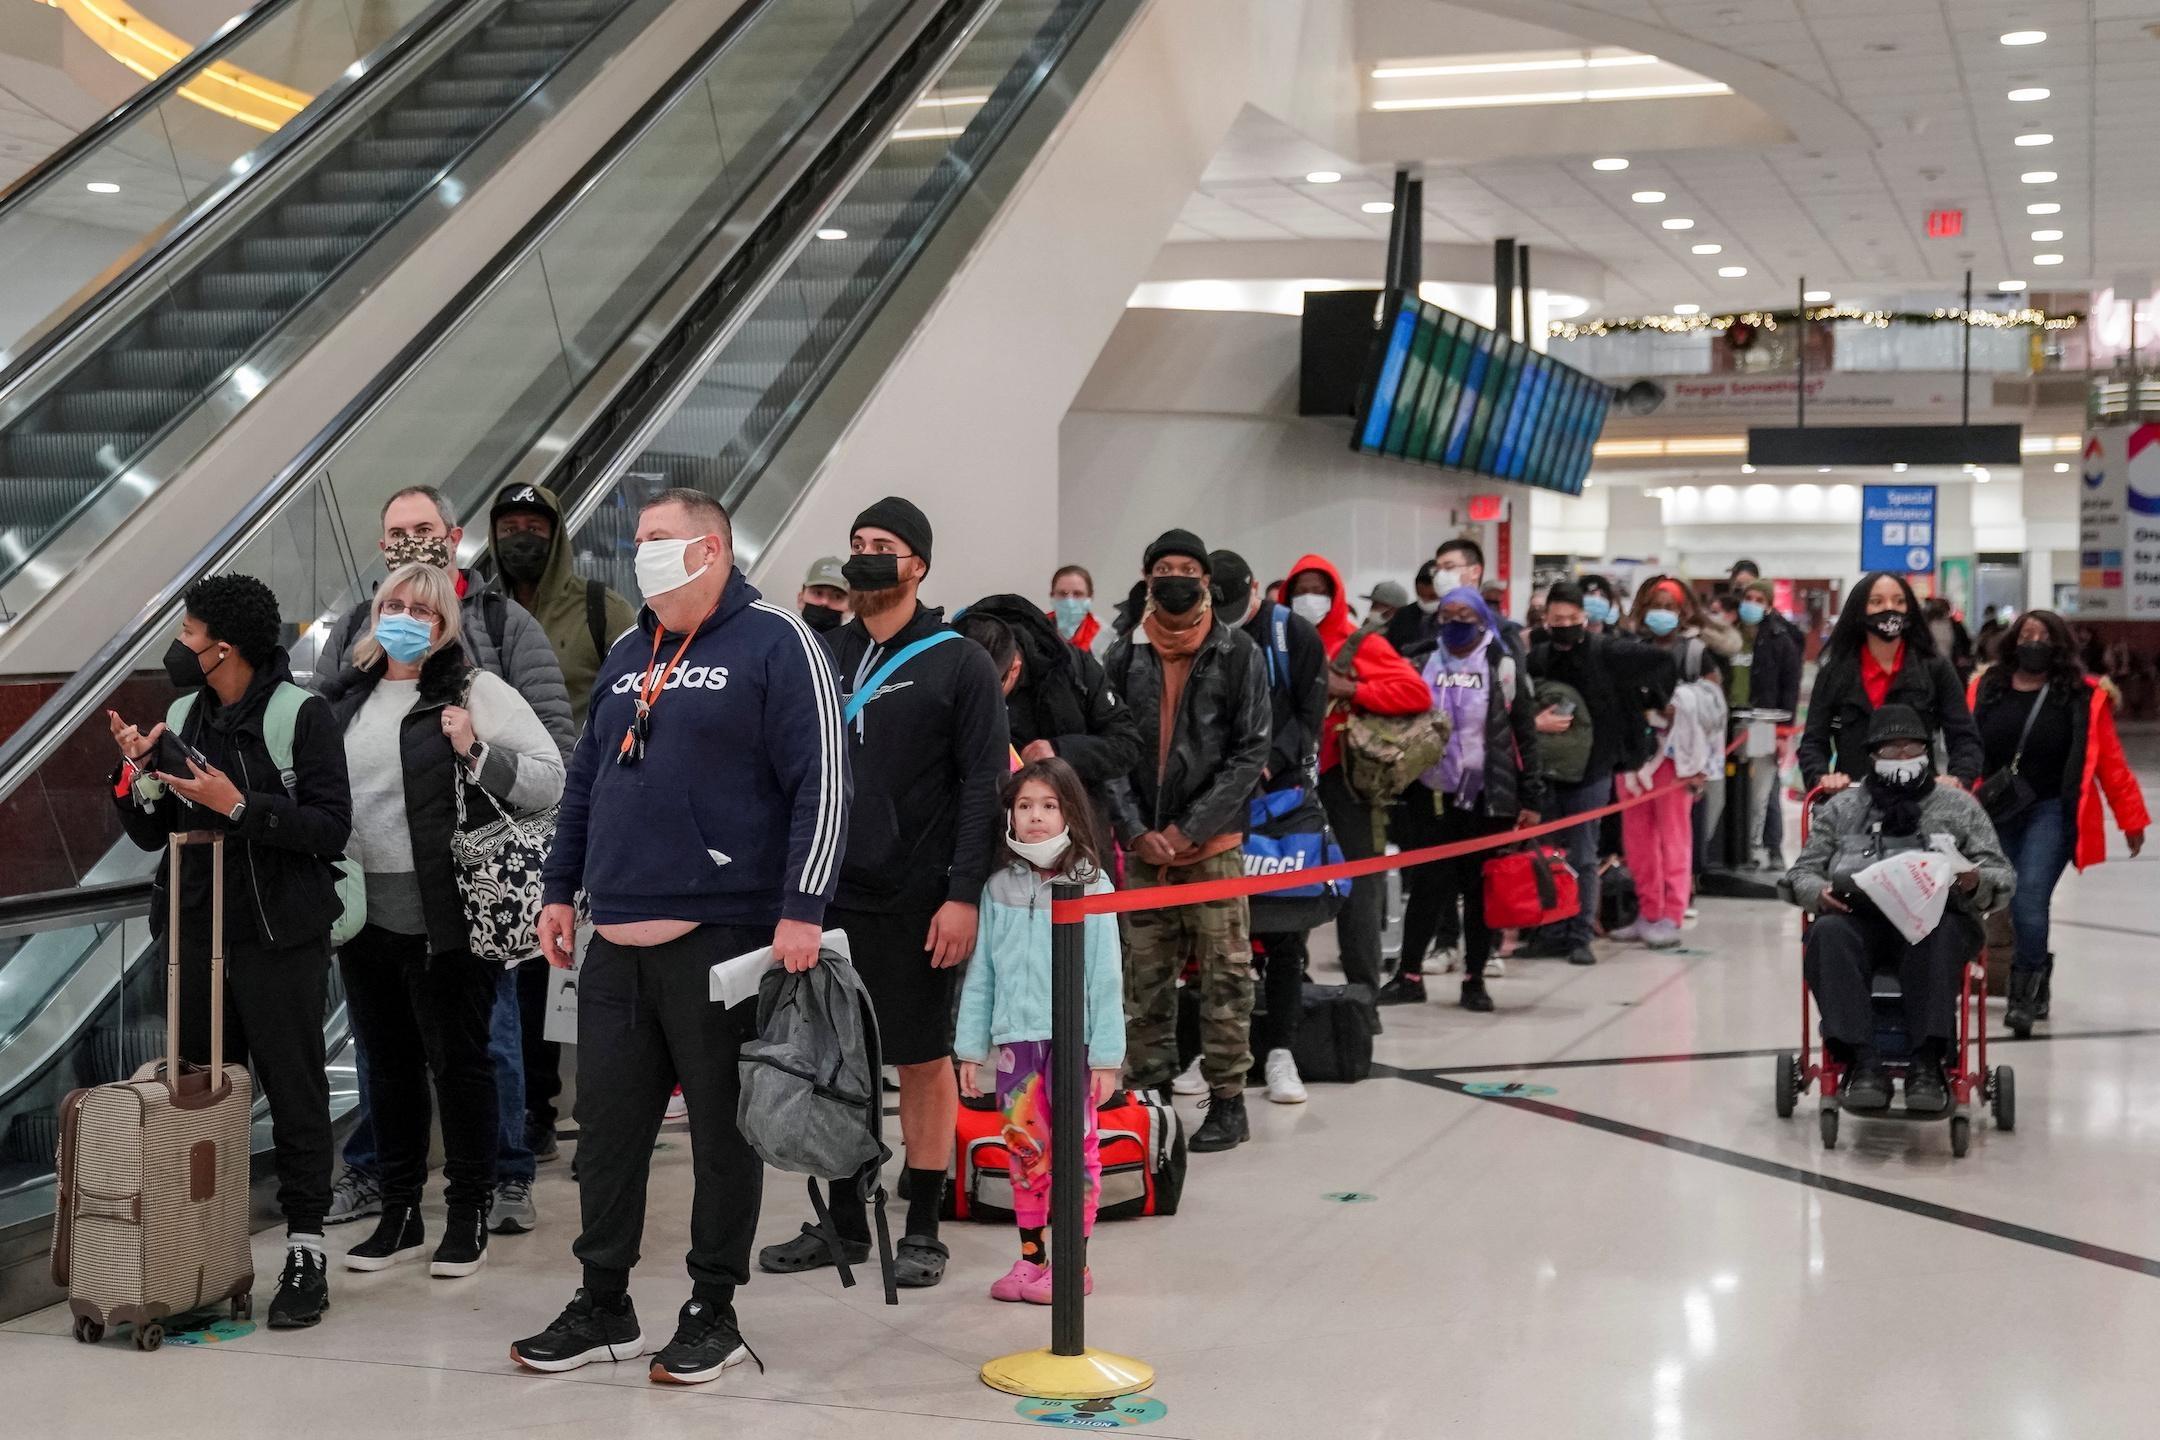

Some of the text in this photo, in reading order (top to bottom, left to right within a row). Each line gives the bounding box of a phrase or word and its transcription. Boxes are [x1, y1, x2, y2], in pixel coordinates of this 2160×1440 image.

[512, 486, 535, 502] A
[612, 660, 729, 694] adidas
[1243, 850, 1305, 876] ucci
